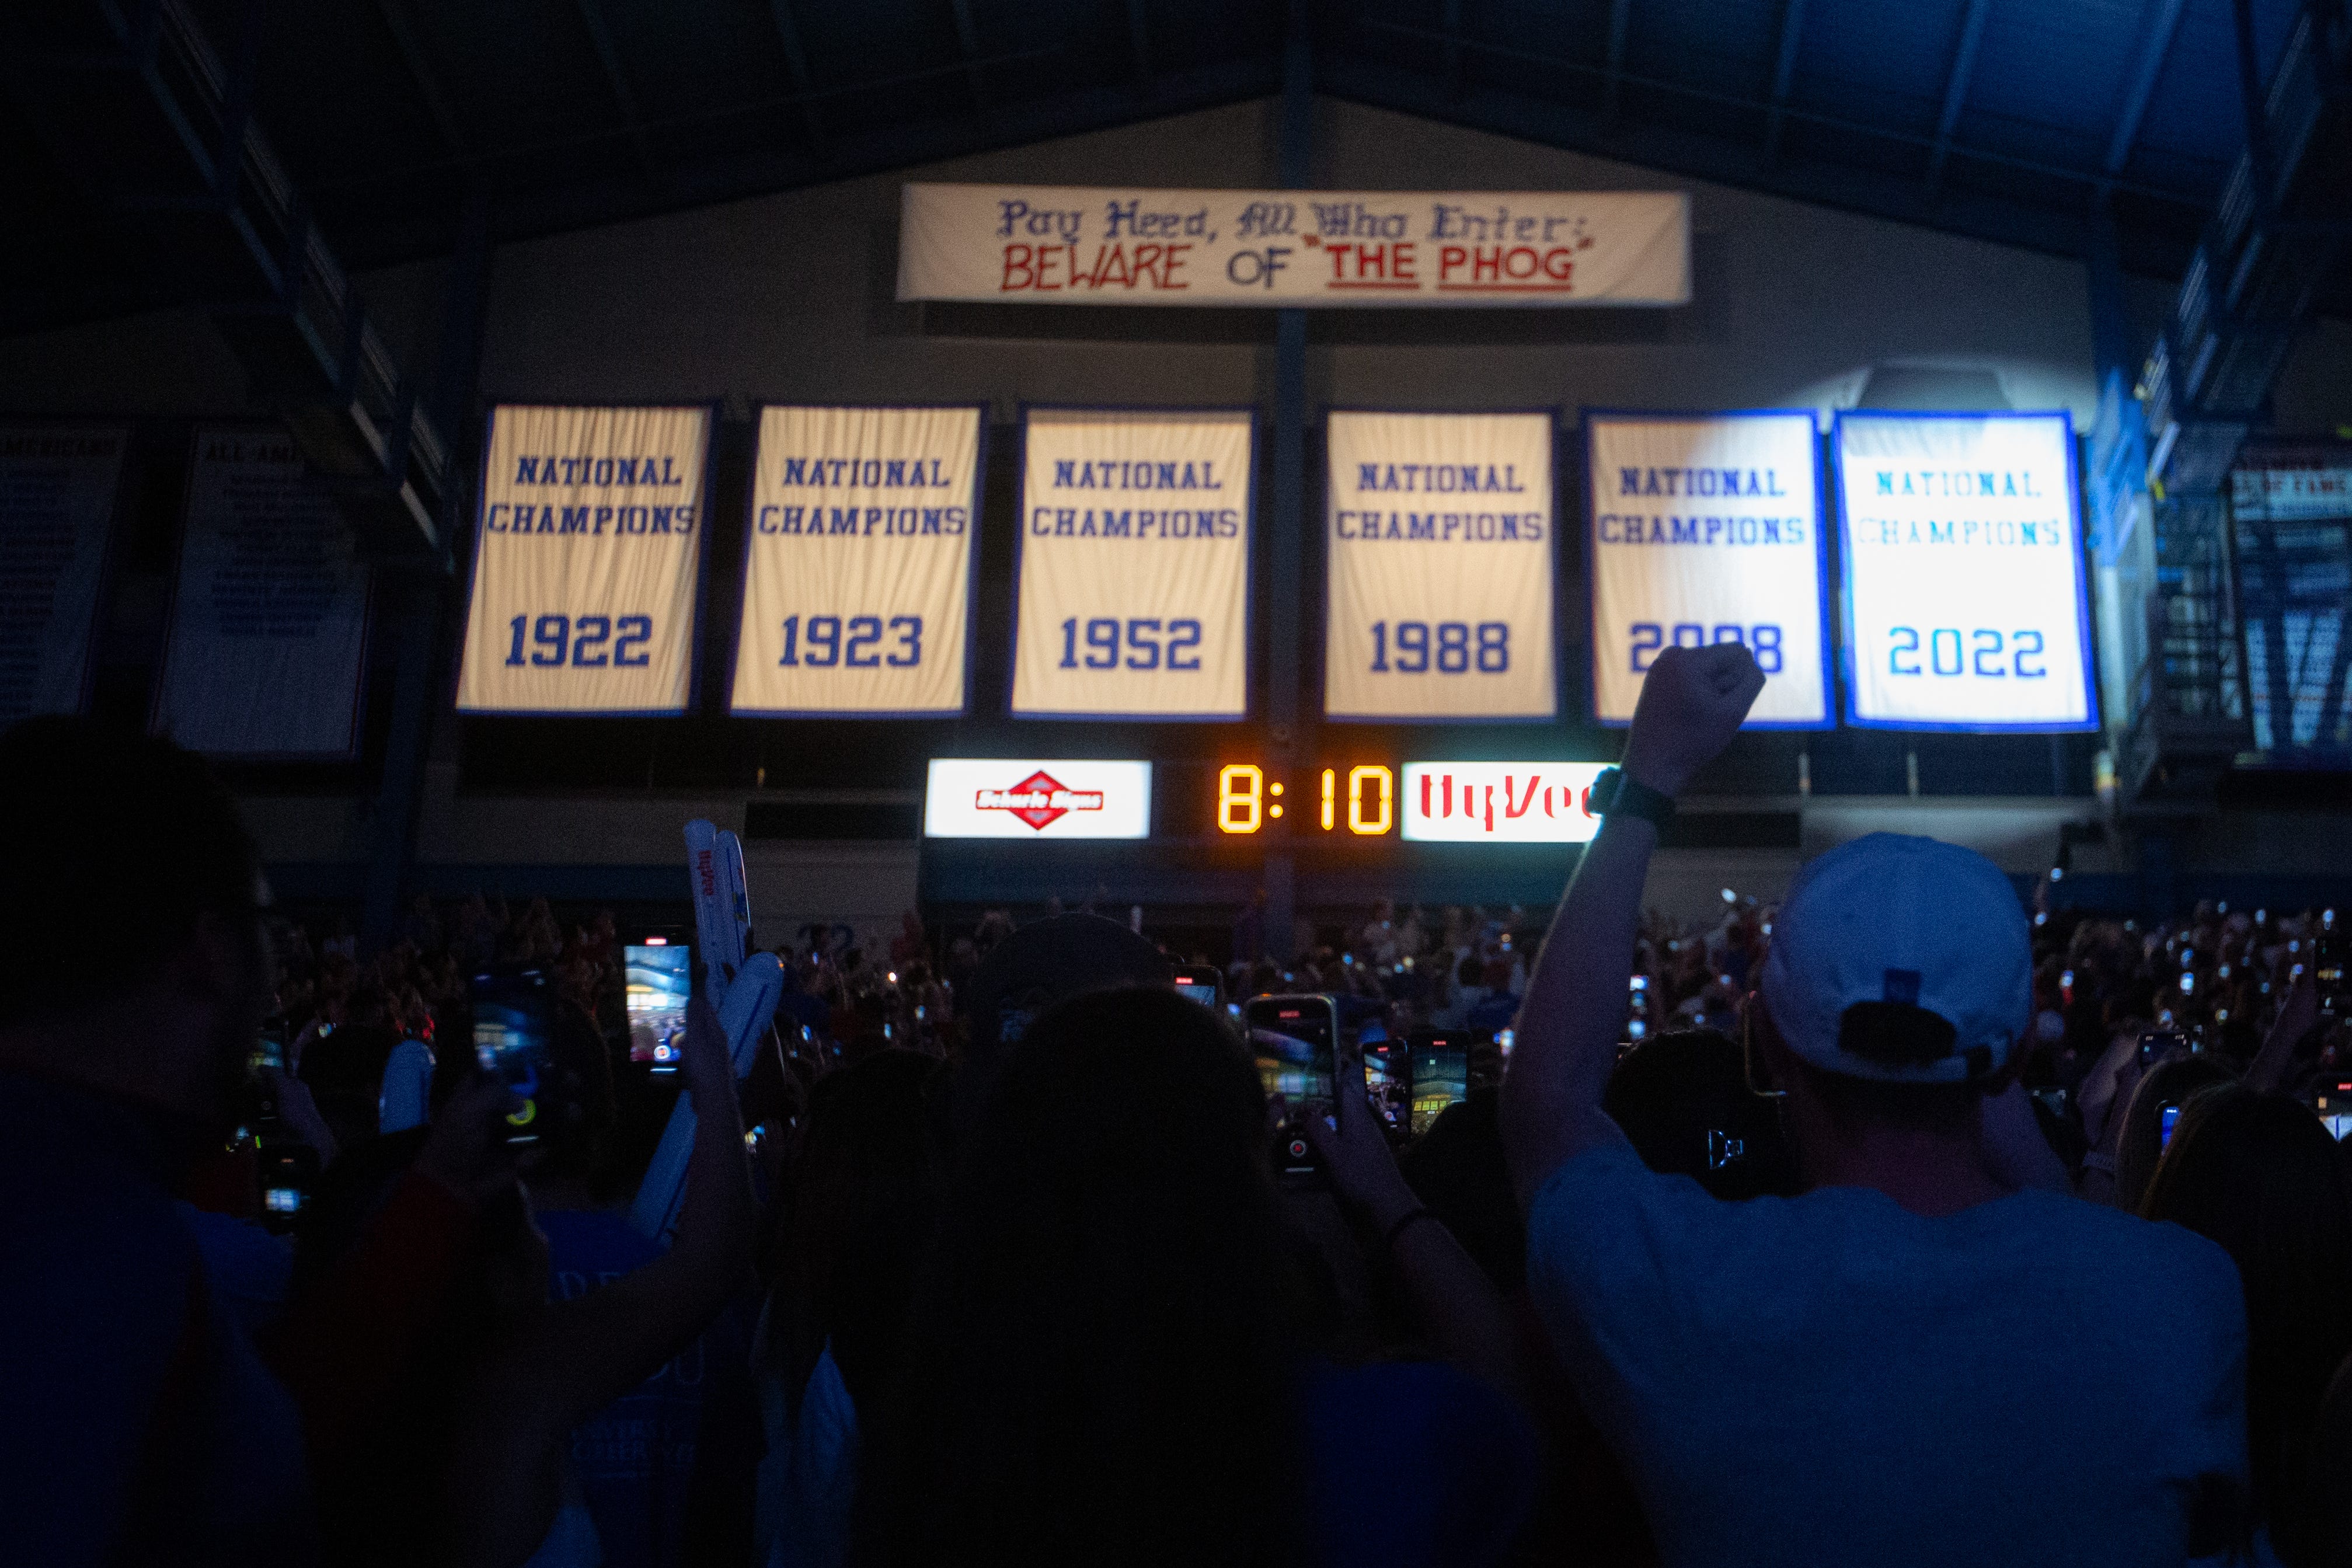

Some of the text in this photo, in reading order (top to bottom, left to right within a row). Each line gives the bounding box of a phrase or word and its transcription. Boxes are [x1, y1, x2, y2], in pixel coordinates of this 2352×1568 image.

[997, 200, 1082, 245] Pay
[1105, 199, 1216, 244] Heed,
[1237, 201, 1297, 238] All
[1309, 202, 1407, 239] Who
[1001, 243, 1193, 290] BEWARE
[1226, 246, 1294, 290] OF
[515, 456, 682, 486] NATIONAL
[782, 457, 951, 487] NATIONAL
[1053, 459, 1222, 490] NATIONAL
[1357, 464, 1525, 493] NATIONAL
[1619, 467, 1787, 497] NATIONAL
[1876, 471, 2041, 497] NATIONAL
[487, 503, 696, 535] CHAMPIONS
[759, 505, 966, 536] CHAMPIONS
[1032, 507, 1238, 538] CHAMPIONS
[1337, 511, 1542, 541] CHAMPIONS
[1598, 514, 1805, 545] CHAMPIONS
[1858, 518, 2061, 546] CHAMPIONS
[505, 614, 653, 667] 1922
[779, 615, 923, 667] 1923
[1058, 617, 1201, 670] 1952
[1370, 621, 1510, 673] 1988
[1889, 626, 2046, 678] 2022
[1218, 764, 1393, 835] 8:10
